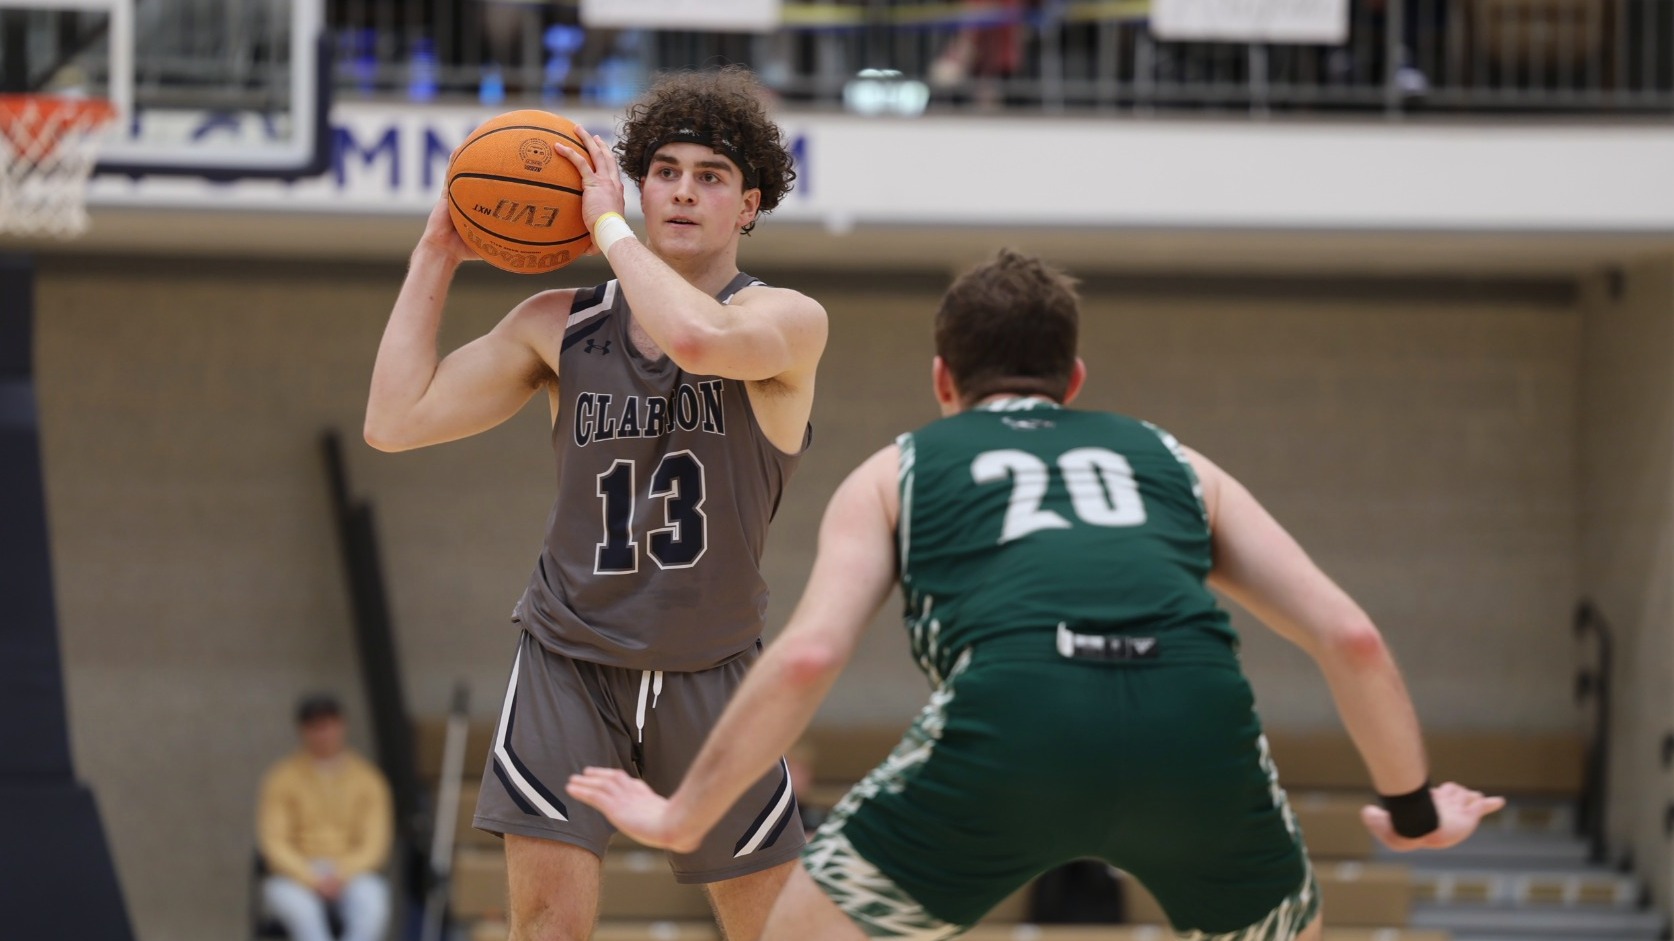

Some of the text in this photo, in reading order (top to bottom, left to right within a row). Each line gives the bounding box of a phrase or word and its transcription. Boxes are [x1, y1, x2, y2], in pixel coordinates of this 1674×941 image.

[472, 199, 559, 228] EVO NXT
[574, 379, 725, 447] CLARION
[593, 449, 708, 575] 13
[970, 447, 1147, 544] 20
